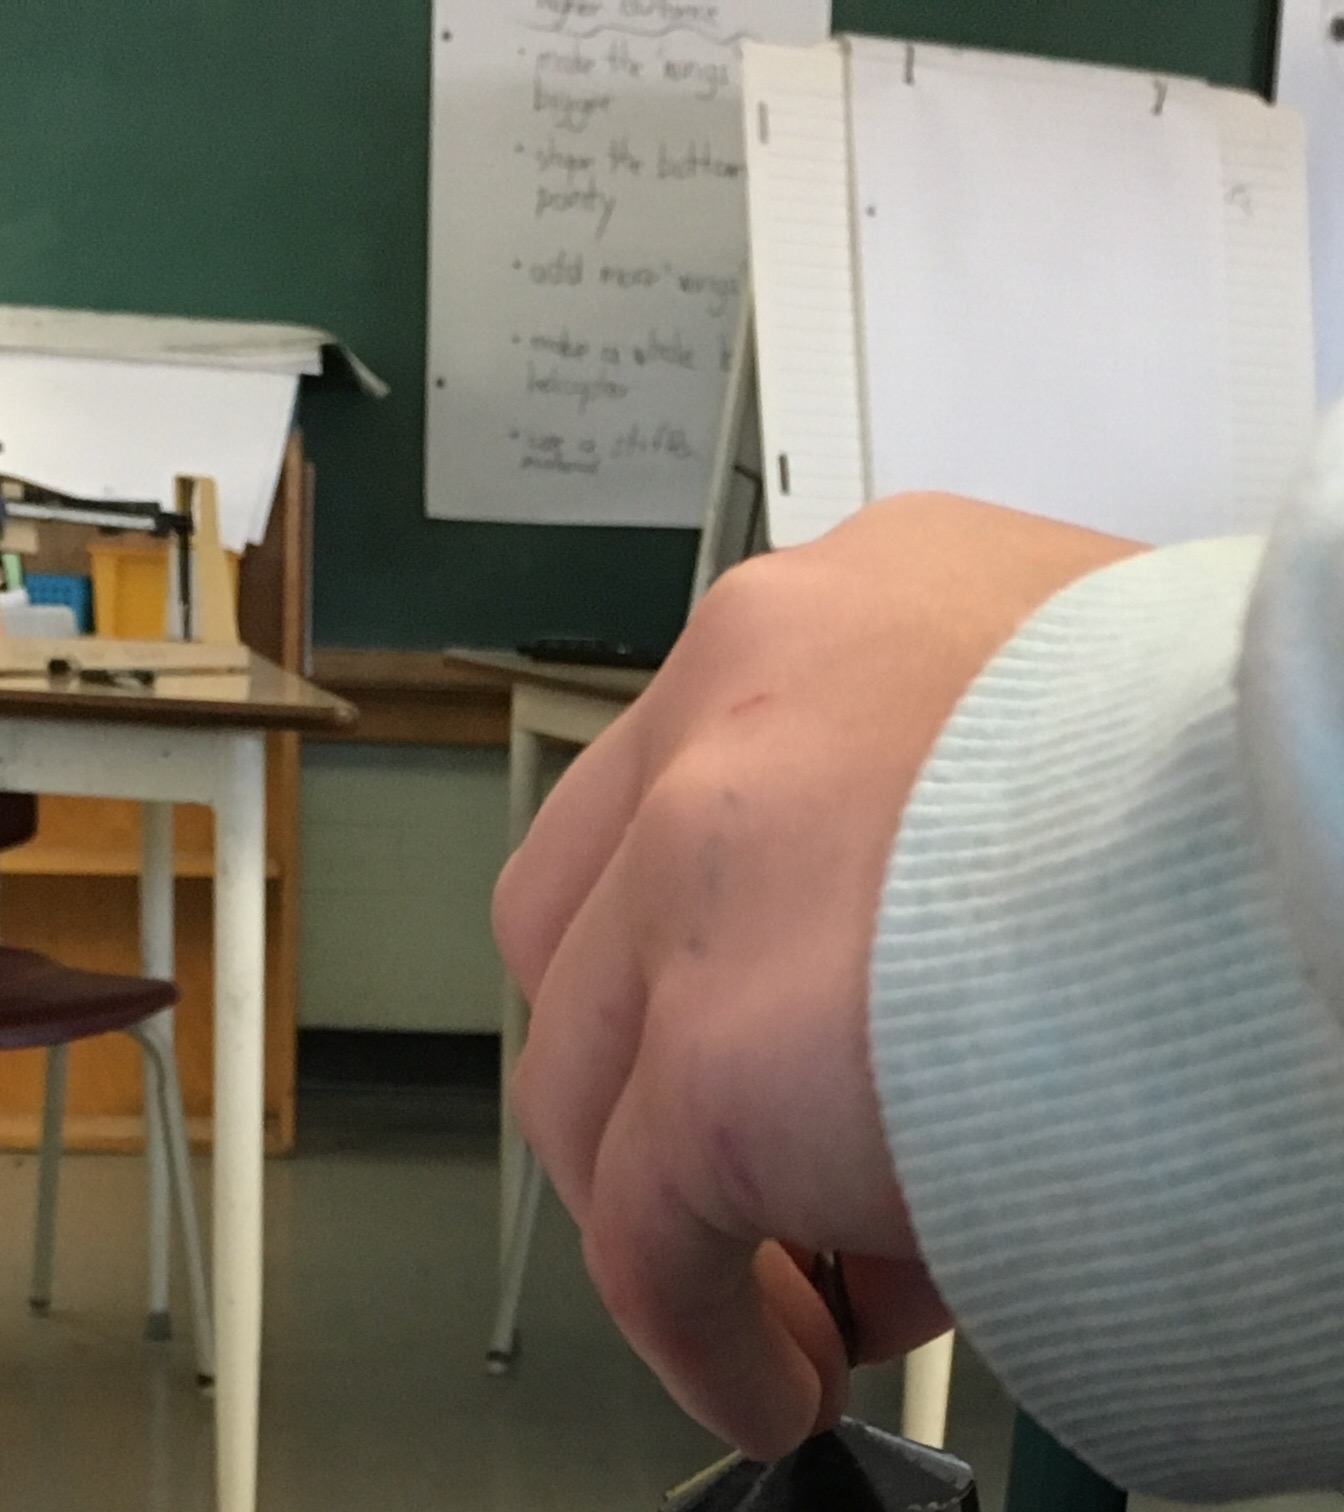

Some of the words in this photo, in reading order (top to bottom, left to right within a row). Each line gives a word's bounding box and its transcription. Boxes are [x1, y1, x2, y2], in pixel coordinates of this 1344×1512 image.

[606, 38, 644, 77] the
[608, 133, 646, 176] the
[528, 249, 584, 286] add
